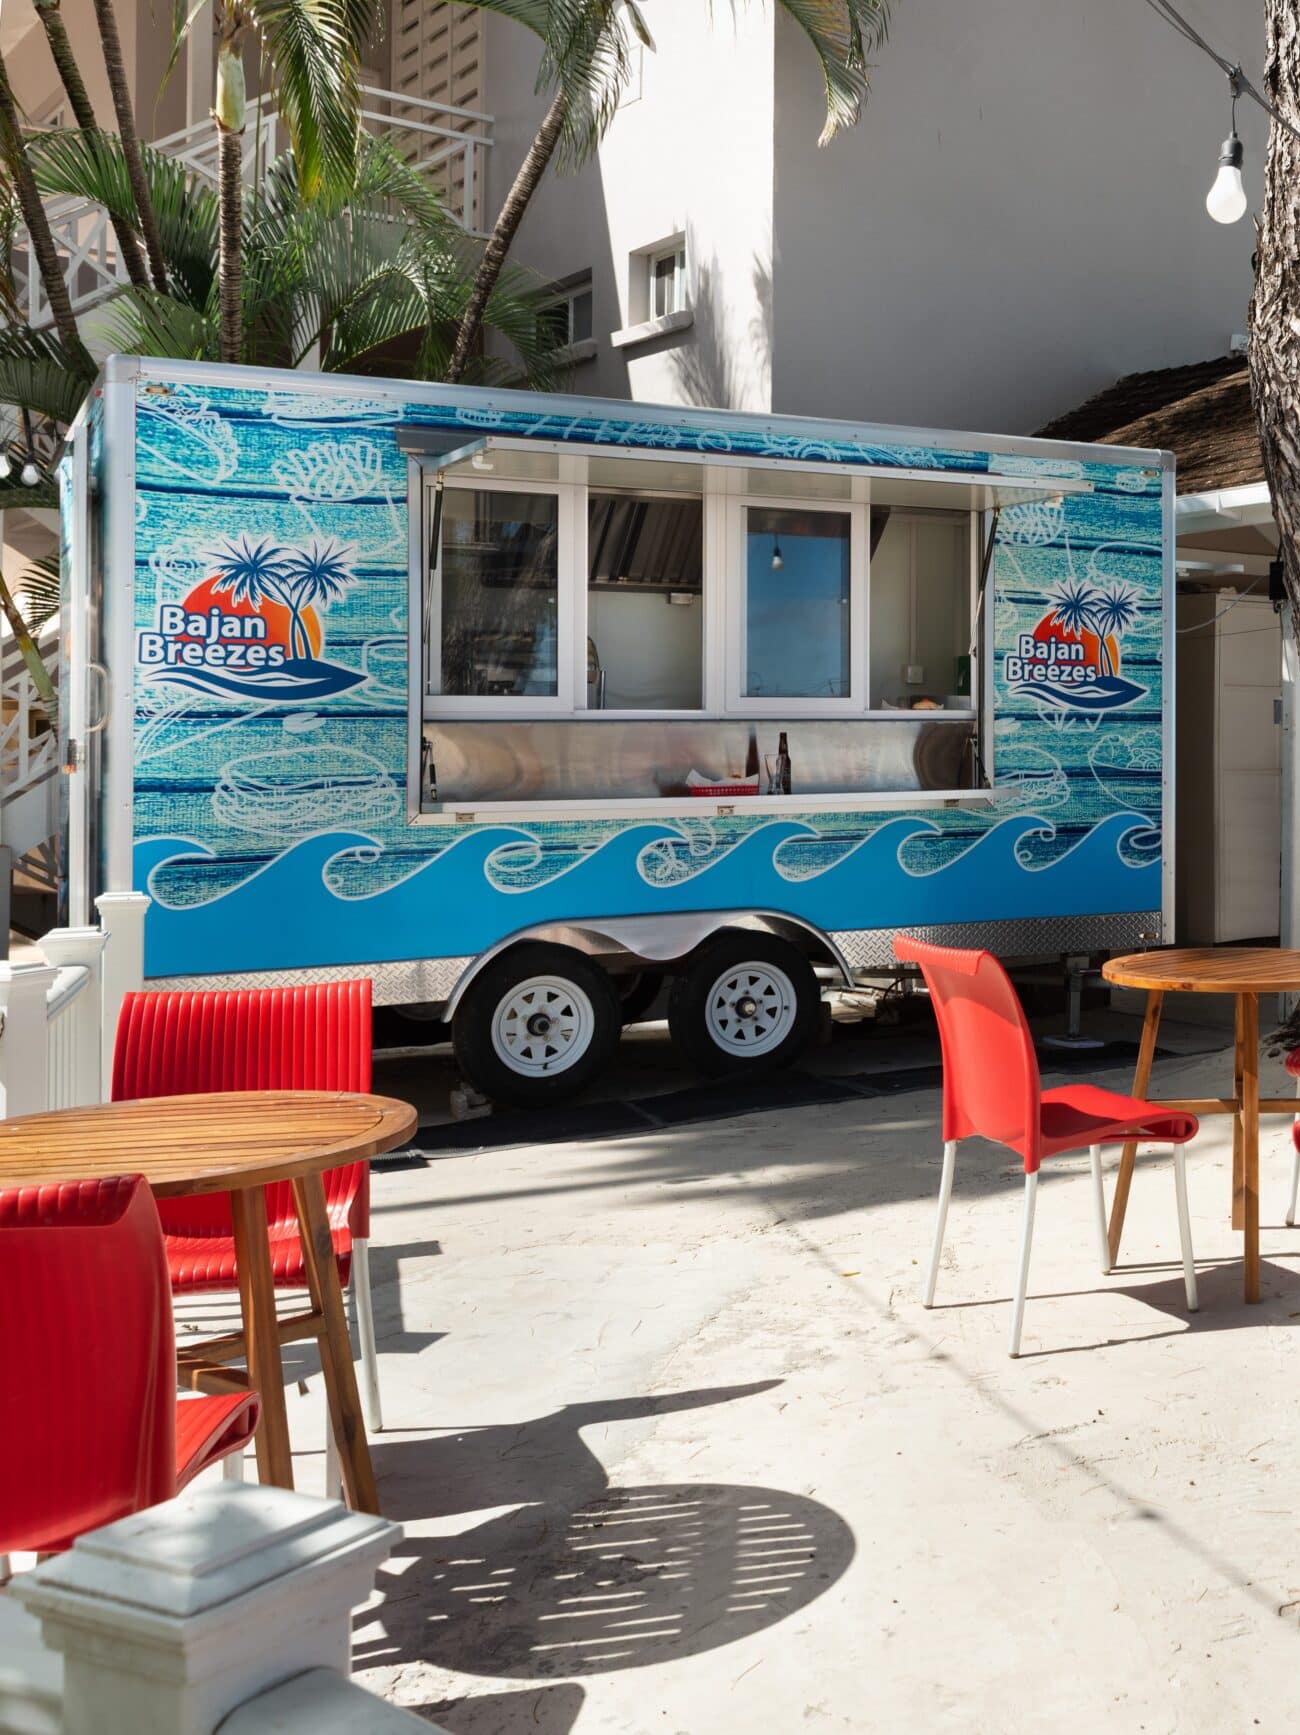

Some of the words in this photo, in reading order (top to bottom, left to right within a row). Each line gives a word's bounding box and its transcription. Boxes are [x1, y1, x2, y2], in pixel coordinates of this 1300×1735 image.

[161, 605, 266, 642] Bajan
[139, 633, 286, 666] Breezes
[1020, 635, 1084, 665] Bajan
[1007, 656, 1097, 681] Breezes
